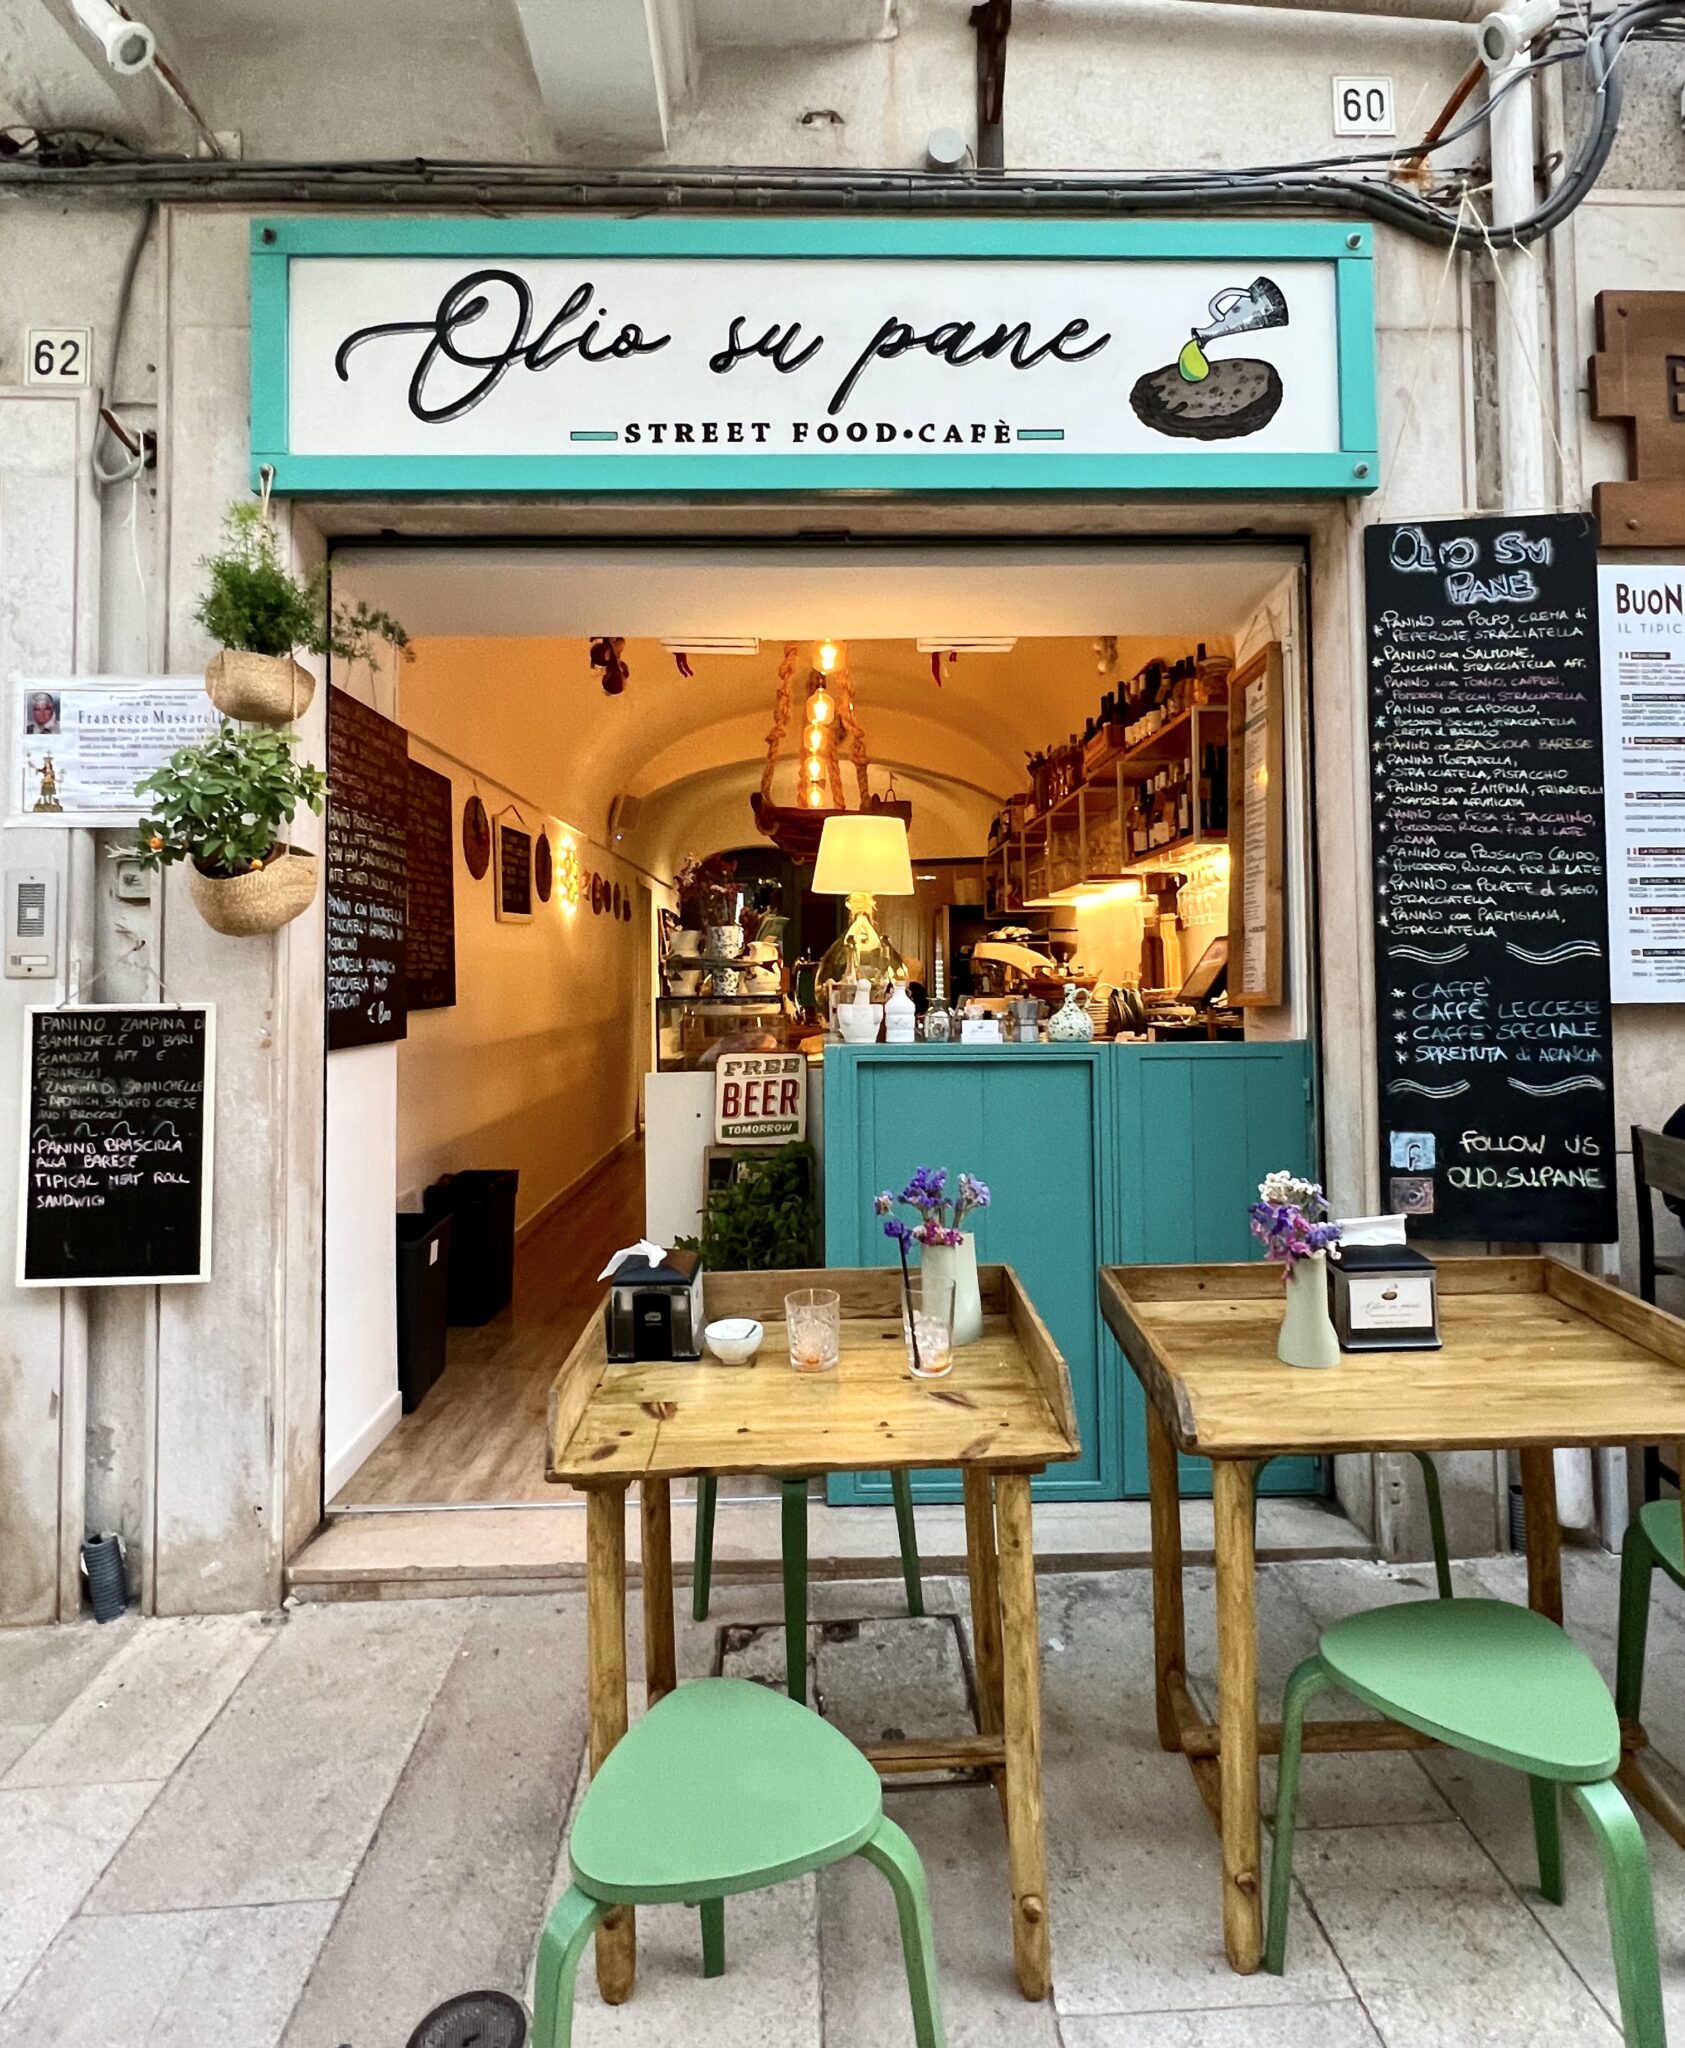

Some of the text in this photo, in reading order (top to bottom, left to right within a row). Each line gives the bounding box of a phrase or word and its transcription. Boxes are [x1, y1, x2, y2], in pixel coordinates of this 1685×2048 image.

[1343, 88, 1384, 122] 60
[333, 268, 1113, 425] Olio su pane
[35, 339, 80, 376] 62
[624, 423, 772, 445] STREET
[1389, 526, 1553, 572] OLIO SU
[1446, 569, 1540, 605] PANE
[1380, 610, 1435, 628] PANINO
[1517, 611, 1569, 623] CREMA
[1474, 627, 1584, 641] STRACCIATELLA
[1618, 623, 1632, 634] IL
[1382, 644, 1436, 661] PANINO
[1463, 659, 1557, 673] STRACCIATELLA
[1383, 674, 1430, 690] PANINO
[1499, 690, 1589, 702] STRACCIATELLA
[1384, 700, 1435, 715] PANINO
[77, 709, 149, 725] Francesco
[1385, 734, 1430, 751] PANINO
[1538, 738, 1594, 750] BARESE
[1385, 753, 1433, 767] PANINO
[1492, 768, 1569, 780] PISTACCHIO
[1386, 778, 1438, 794] PANINO
[1385, 807, 1431, 821] PANINO
[1464, 810, 1498, 822] FESA
[1387, 844, 1441, 860] PANINO
[1388, 874, 1448, 892] PANINO
[1389, 894, 1498, 906] STRACCIATELLA
[1390, 907, 1443, 922] PANINO
[1390, 924, 1498, 938] STRACCIATELLA
[1497, 1000, 1602, 1019] LECCESE
[41, 1016, 106, 1032] PANINO
[120, 1017, 186, 1032] ZAMPINA
[1495, 1021, 1603, 1040] SPECIALE
[142, 1035, 155, 1048] DI
[163, 1034, 194, 1048] BARI
[1415, 1045, 1509, 1065] SPREMUTA
[723, 1058, 801, 1077] FREE
[722, 1079, 801, 1119] BEER
[728, 1123, 793, 1136] TOMORROW
[103, 1137, 183, 1153] BRASCIOLA
[1458, 1130, 1600, 1156] FOLLOW US
[84, 1154, 139, 1169] BARESE
[34, 1172, 99, 1189] TIPICAL
[153, 1171, 190, 1184] ROLL
